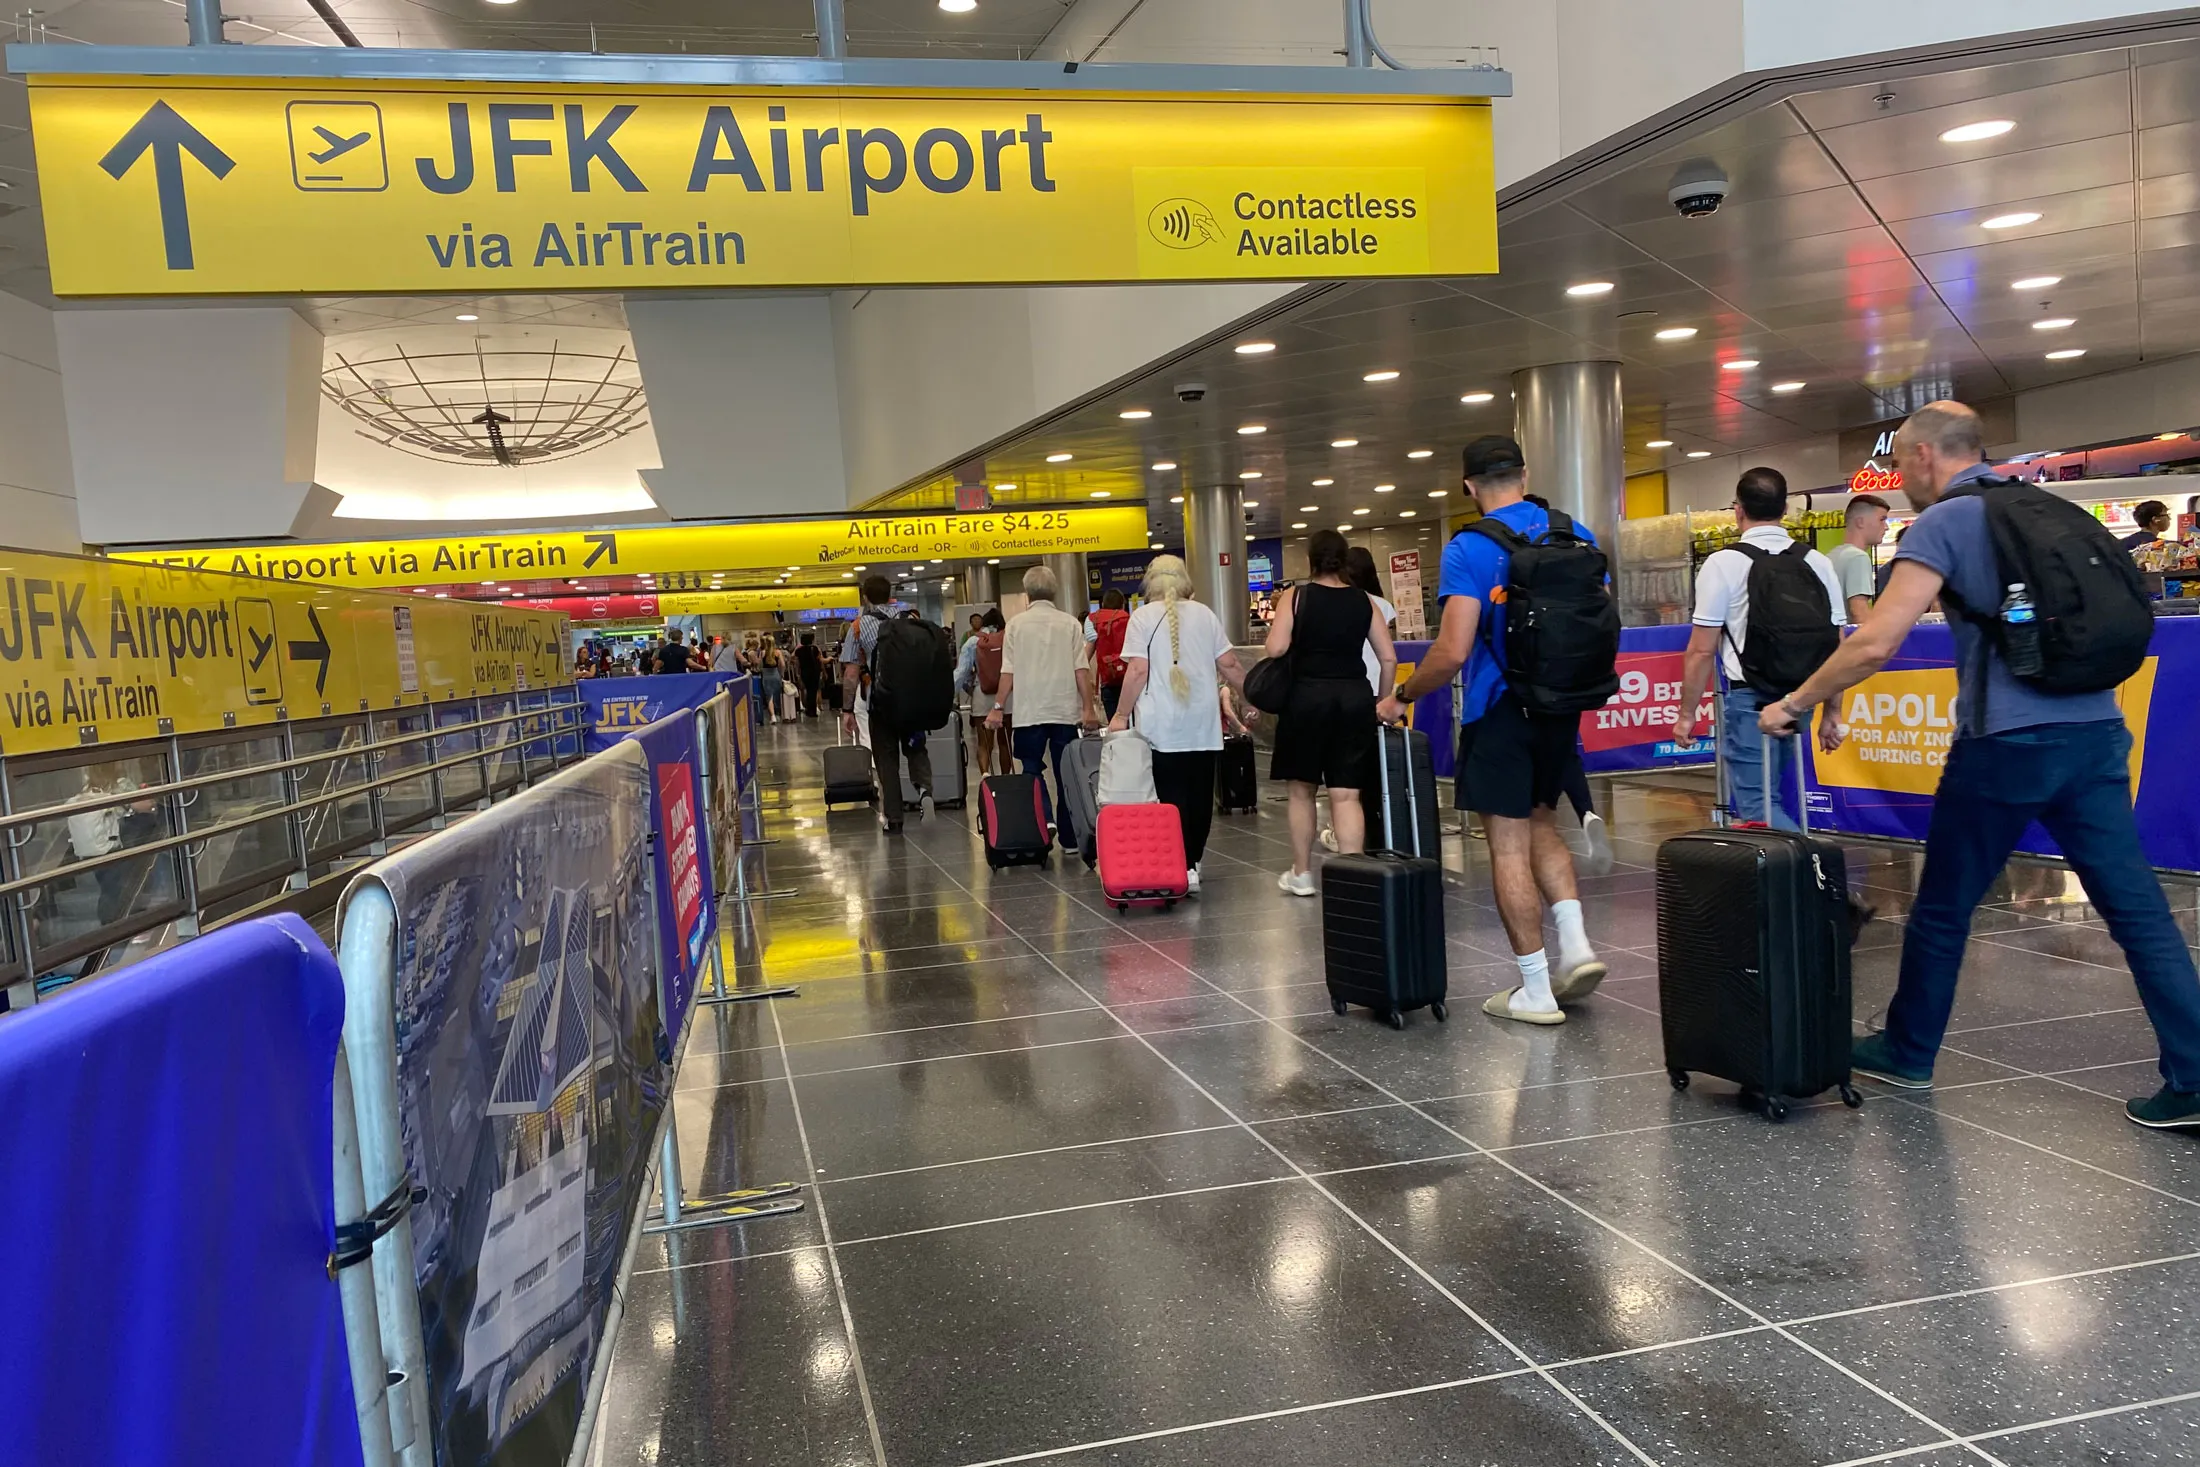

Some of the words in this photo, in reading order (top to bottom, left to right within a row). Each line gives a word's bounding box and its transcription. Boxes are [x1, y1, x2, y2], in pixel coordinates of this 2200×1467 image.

[415, 103, 649, 195] JFK
[686, 104, 1057, 216] Airport
[1233, 191, 1417, 222] Contactless
[426, 223, 513, 268] via
[533, 220, 746, 267] AirTrain
[1237, 227, 1379, 257] Available
[1872, 431, 1899, 457] AI
[1853, 470, 1903, 491] Coor
[847, 517, 937, 538] AirTrain
[945, 516, 995, 535] Fare
[1002, 511, 1070, 534] $4.25
[857, 543, 919, 557] MetroCard
[991, 537, 1055, 550] Contactless
[1056, 535, 1101, 548] Payment
[230, 551, 358, 581] Airport
[368, 546, 420, 575] via
[432, 539, 567, 572] AirTrain
[0, 577, 97, 662] JFK
[110, 585, 234, 678] Airport
[470, 614, 494, 653] JFK
[495, 616, 530, 661] Airport
[474, 660, 486, 683] via
[486, 659, 511, 682] AirTrain
[5, 679, 53, 729] via
[62, 675, 160, 725] AirTrain
[595, 701, 650, 727] JFK
[1659, 745, 1671, 754] TO
[1852, 729, 1883, 744] FOR
[1886, 730, 1921, 746] ANY
[1859, 747, 1922, 766] DURING
